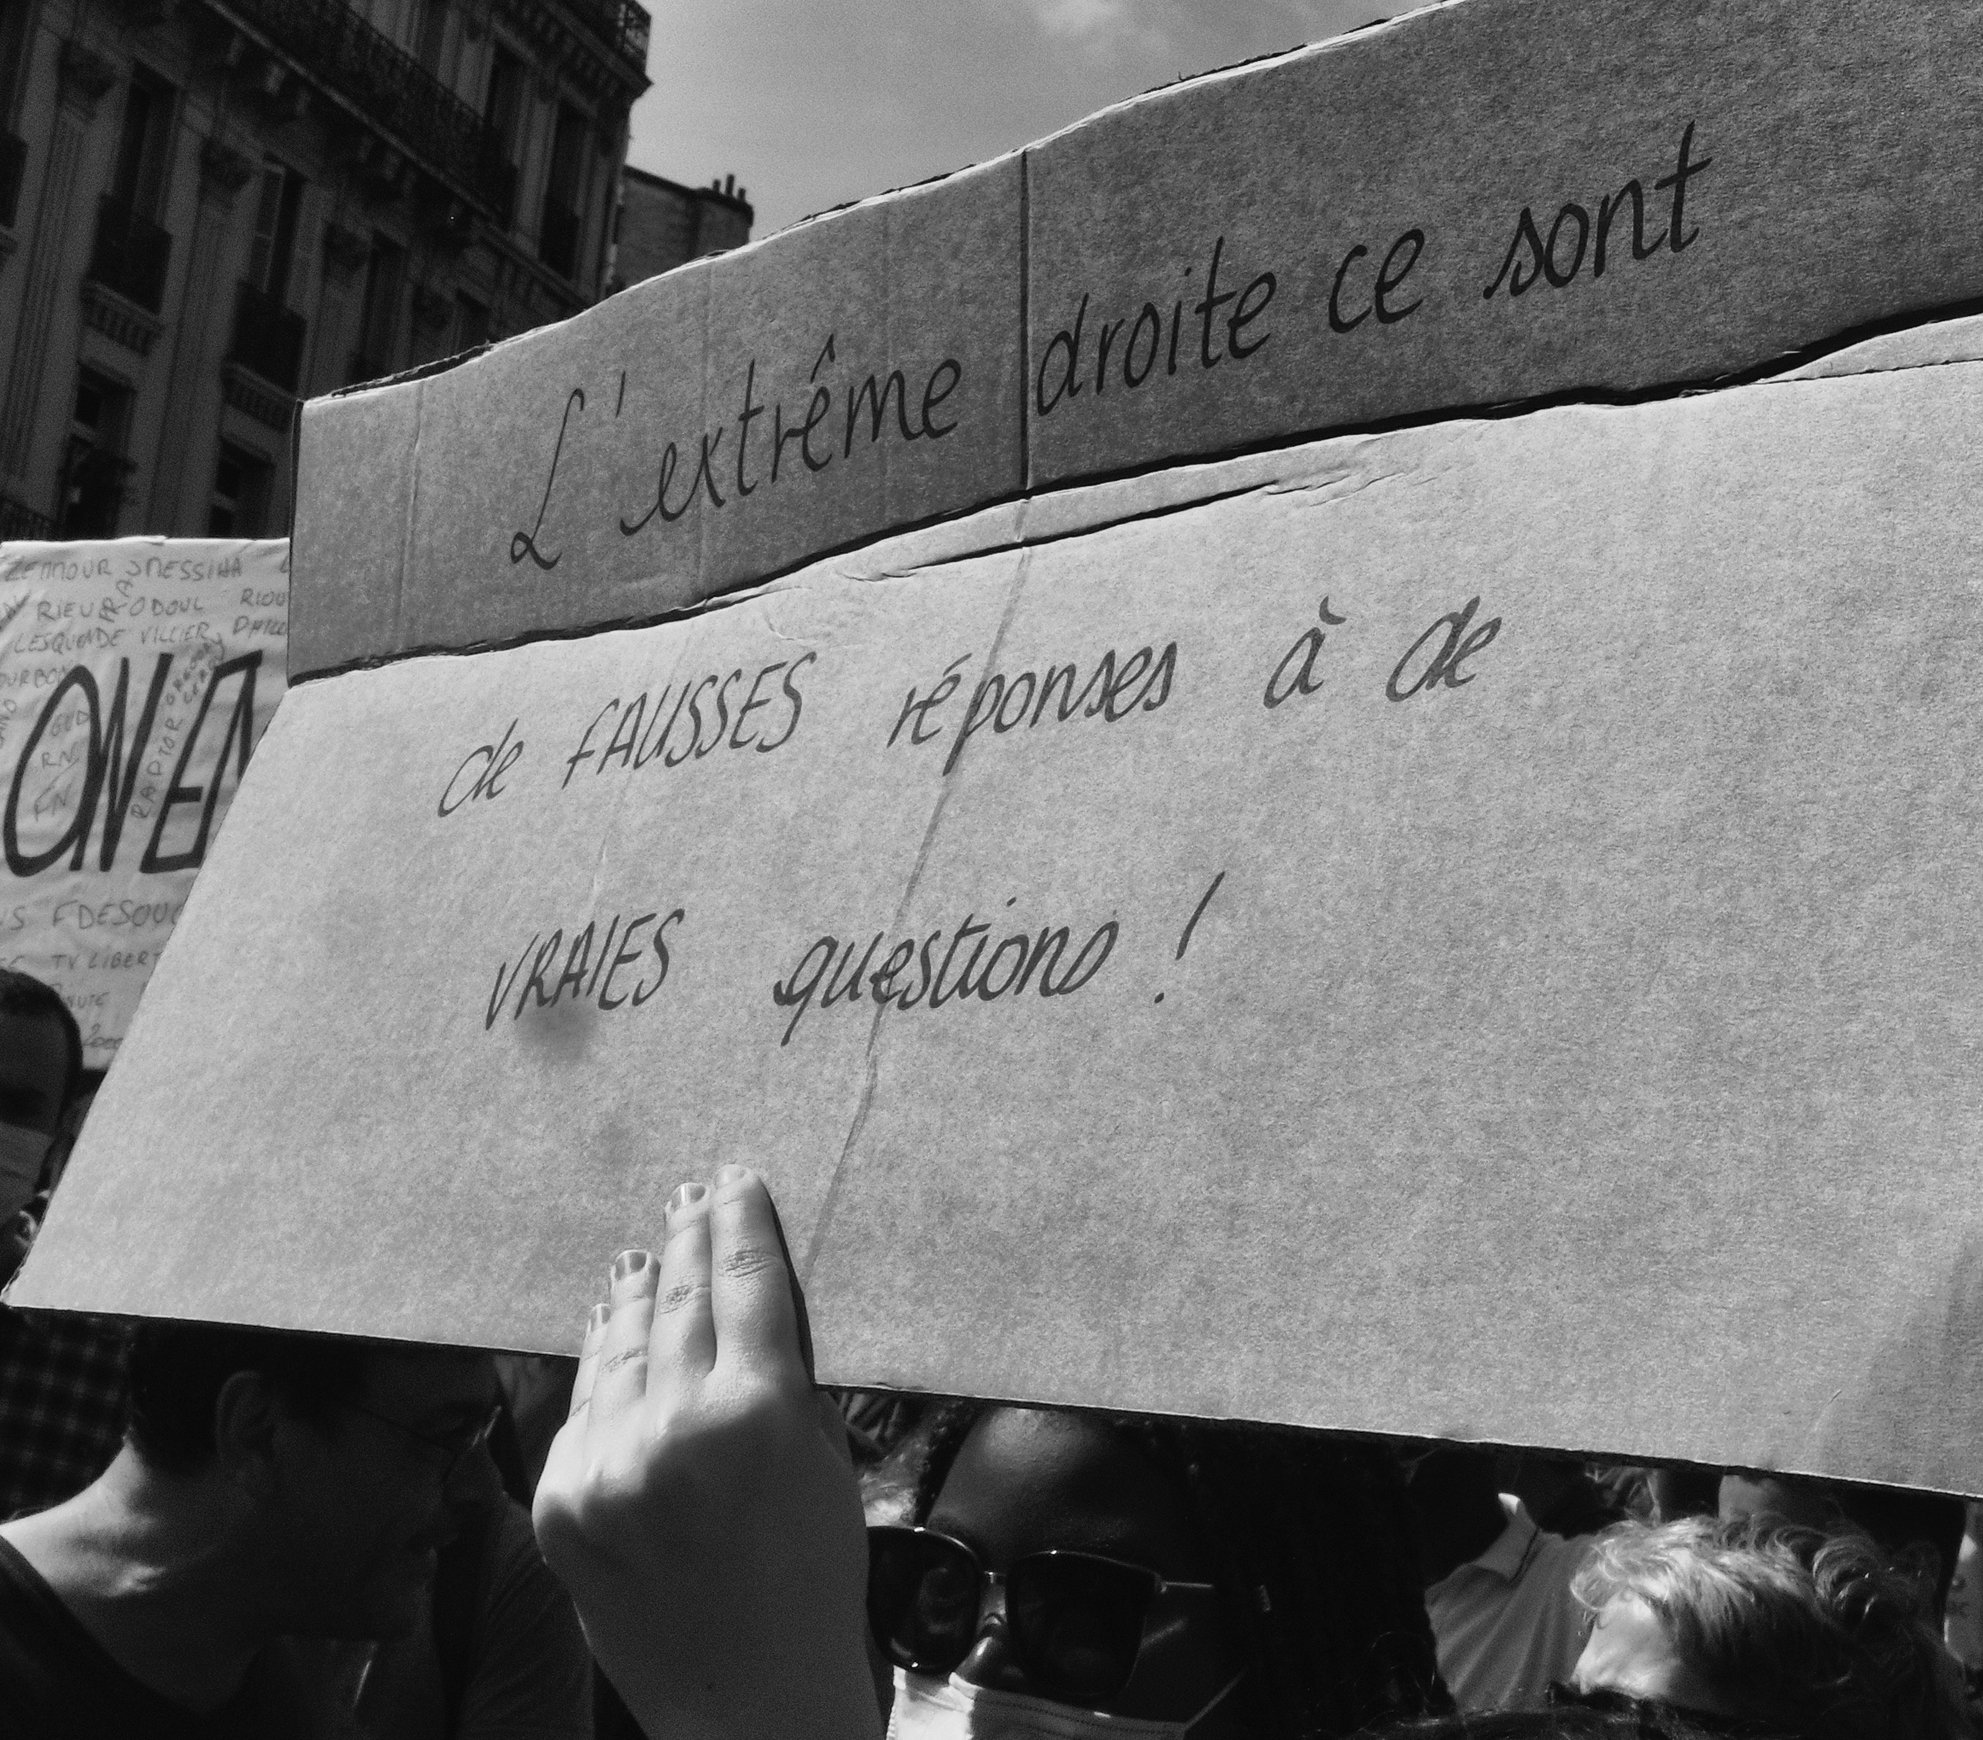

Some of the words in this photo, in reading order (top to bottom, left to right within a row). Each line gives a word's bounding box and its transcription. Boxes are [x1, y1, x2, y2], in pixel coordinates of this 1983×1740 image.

[510, 333, 963, 571] L'extrême
[1037, 236, 1277, 416] droite
[1327, 228, 1426, 335] ce
[1482, 119, 1713, 301] sont
[437, 718, 525, 818] de
[561, 651, 818, 790] FAUSSES
[886, 640, 1179, 776] réponses
[1263, 595, 1347, 710] à
[1384, 595, 1503, 703] de
[52, 899, 185, 930] FDESOUC
[485, 908, 686, 1032] VRAIES
[772, 896, 1121, 1048] questions
